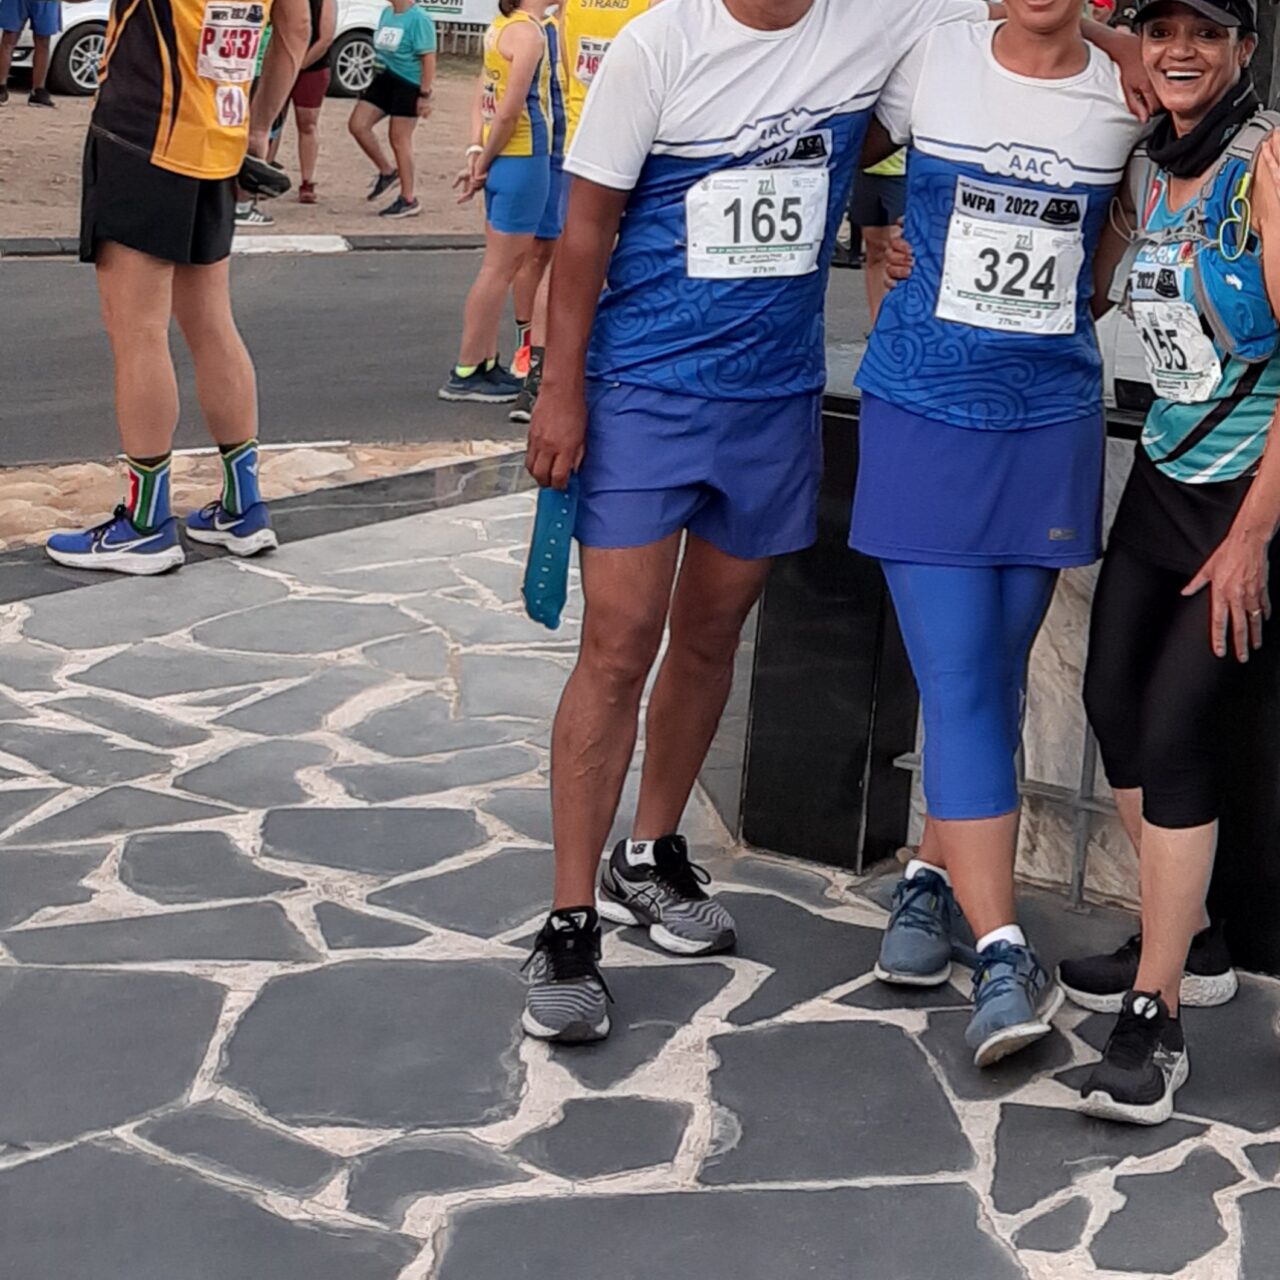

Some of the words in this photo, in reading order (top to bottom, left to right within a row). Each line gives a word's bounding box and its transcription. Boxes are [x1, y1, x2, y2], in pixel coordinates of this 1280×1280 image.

[202, 27, 216, 56] P
[1009, 154, 1053, 176] AAC
[961, 191, 996, 213] WPA
[1004, 195, 1040, 217] 2022
[1050, 201, 1078, 215] ASA
[723, 197, 803, 243] 165
[974, 247, 1056, 300] 324
[1142, 327, 1188, 370] 155
